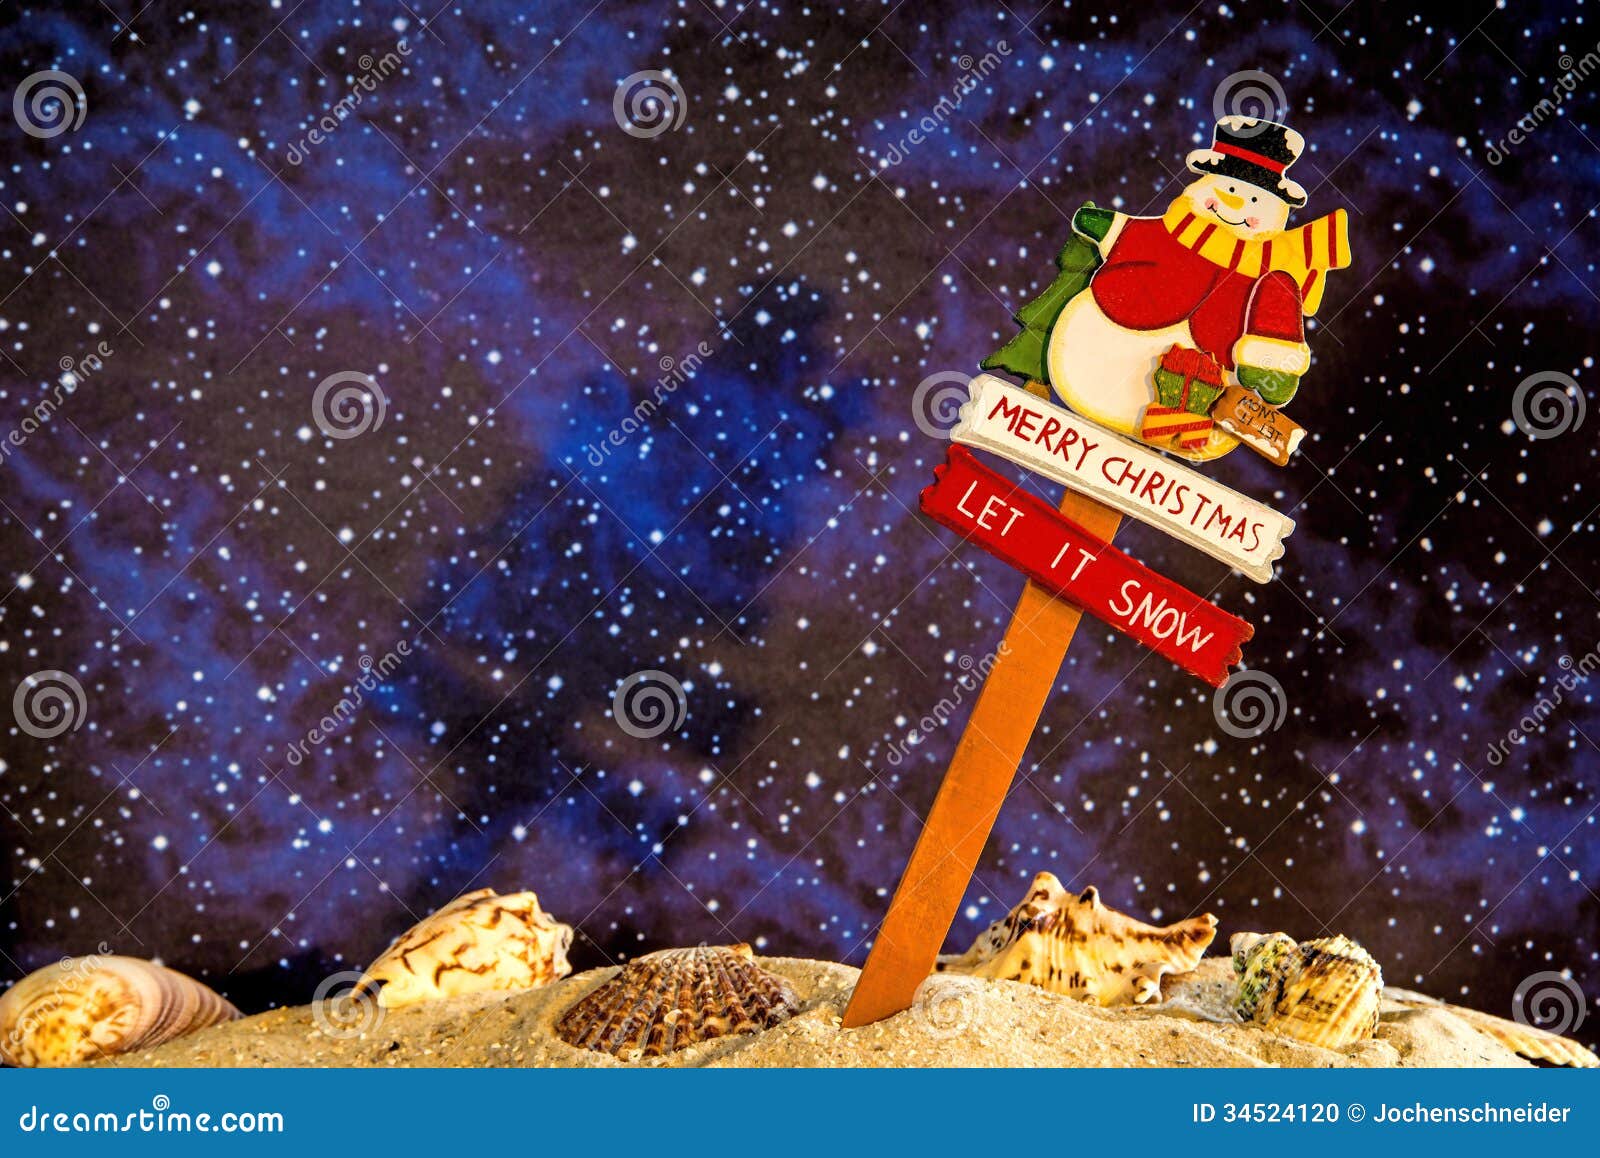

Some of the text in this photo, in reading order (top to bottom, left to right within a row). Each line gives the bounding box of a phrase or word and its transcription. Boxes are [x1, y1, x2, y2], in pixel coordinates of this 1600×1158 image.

[987, 395, 1265, 552] MERRY CHRISTMAS
[956, 480, 1215, 653] LET IT SNOW
